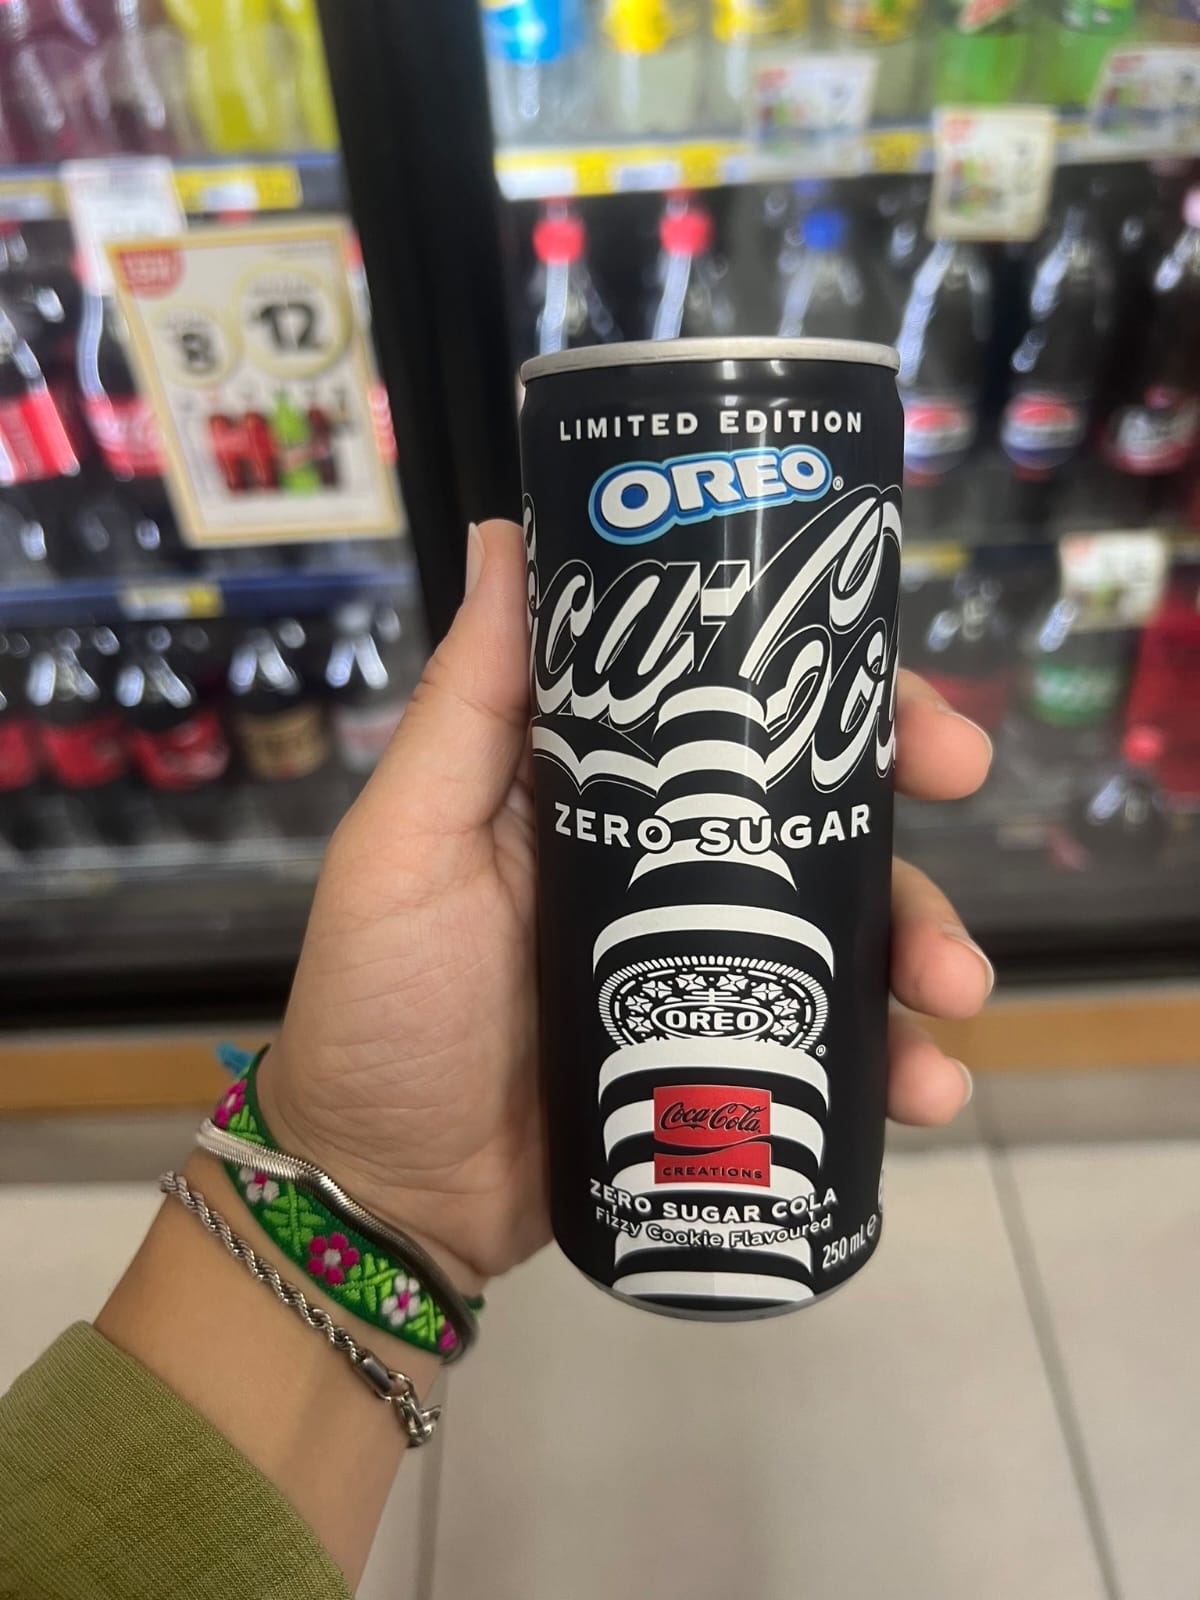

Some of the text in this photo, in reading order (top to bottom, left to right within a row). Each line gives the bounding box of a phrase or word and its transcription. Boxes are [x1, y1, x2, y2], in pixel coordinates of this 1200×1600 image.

[560, 410, 862, 441] LIMITED EDITION
[598, 450, 828, 530] OREO
[554, 801, 871, 853] ZERO SUGAR
[664, 1009, 759, 1031] OREO
[659, 1101, 767, 1133] Coca-Cola
[662, 1166, 763, 1180] CREATIONS
[589, 1178, 838, 1223] ZERO SUGAR COLA
[595, 1206, 832, 1248] Fizzy Cookie Flavoured
[822, 1236, 847, 1269] 250
